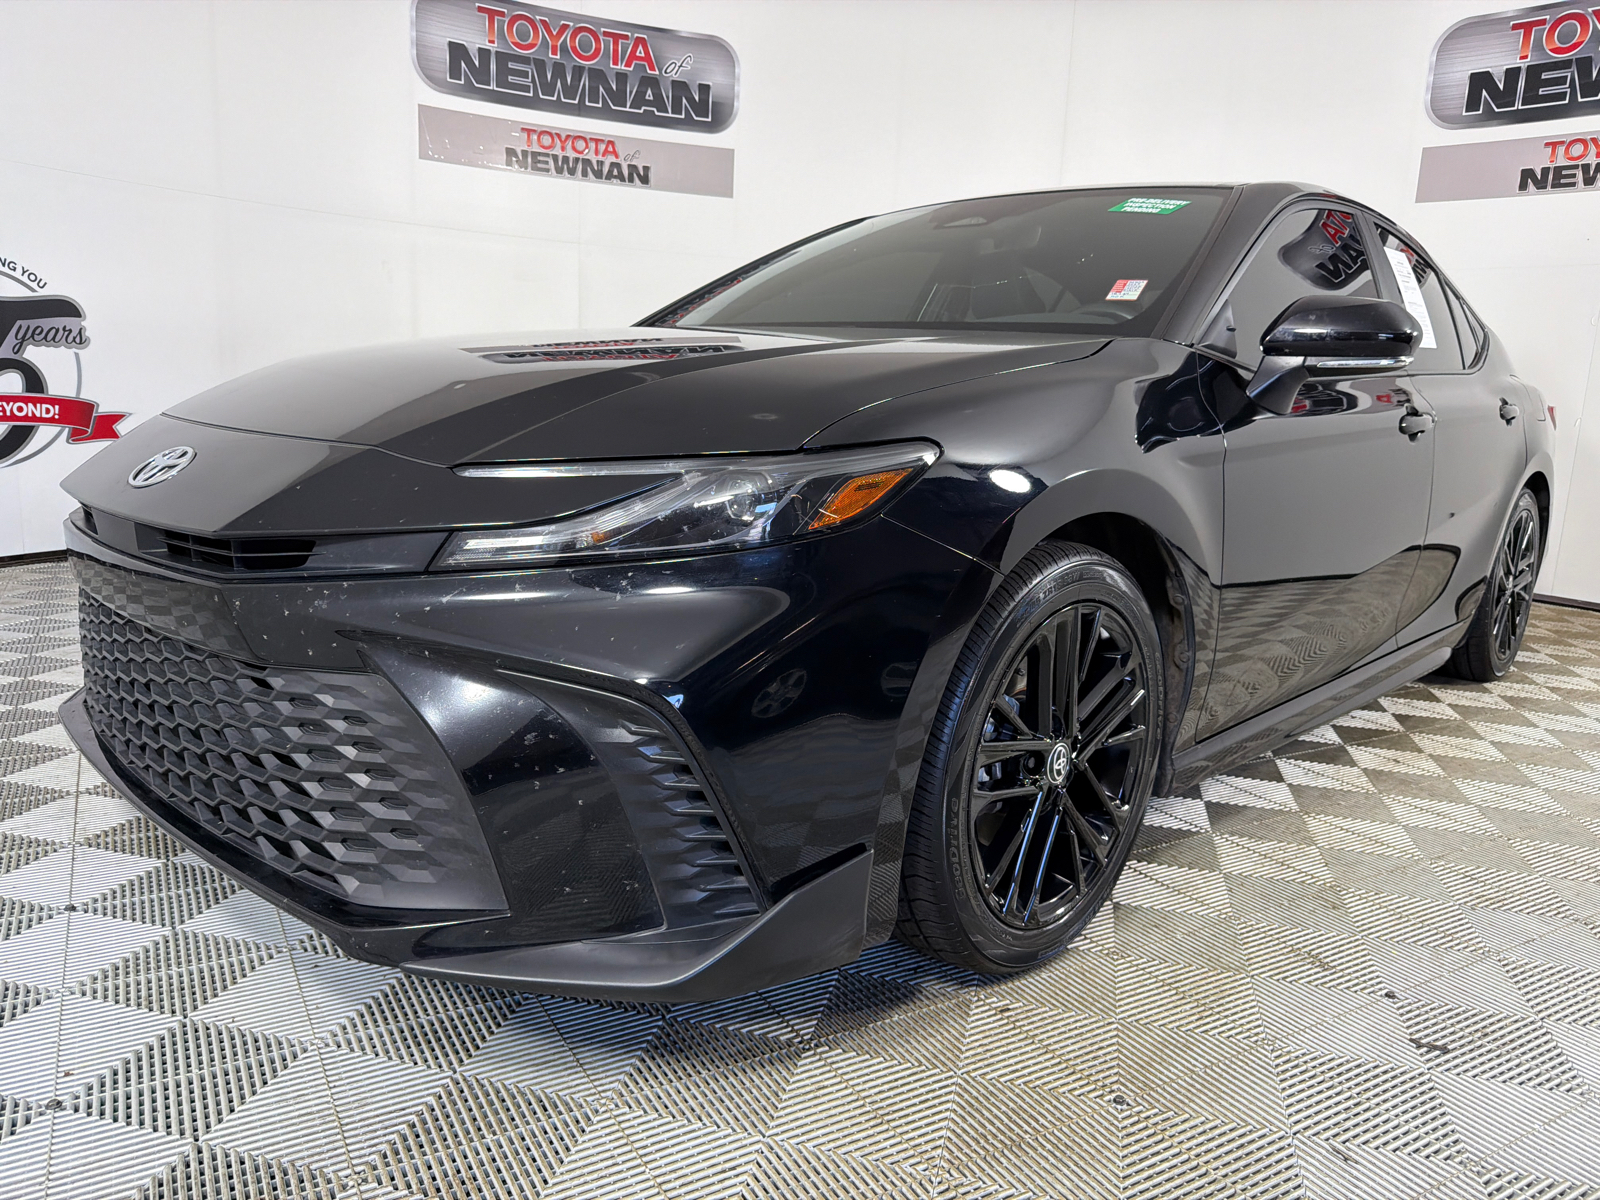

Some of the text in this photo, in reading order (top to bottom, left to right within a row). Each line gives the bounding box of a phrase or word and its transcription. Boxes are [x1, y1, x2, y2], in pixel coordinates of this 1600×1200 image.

[476, 4, 693, 77] TOYOTA of
[447, 40, 711, 121] NEWNAN
[520, 127, 640, 162] TOYOTA of
[505, 147, 650, 185] NEWNAN
[21, 266, 47, 289] YOU
[12, 323, 88, 355] years
